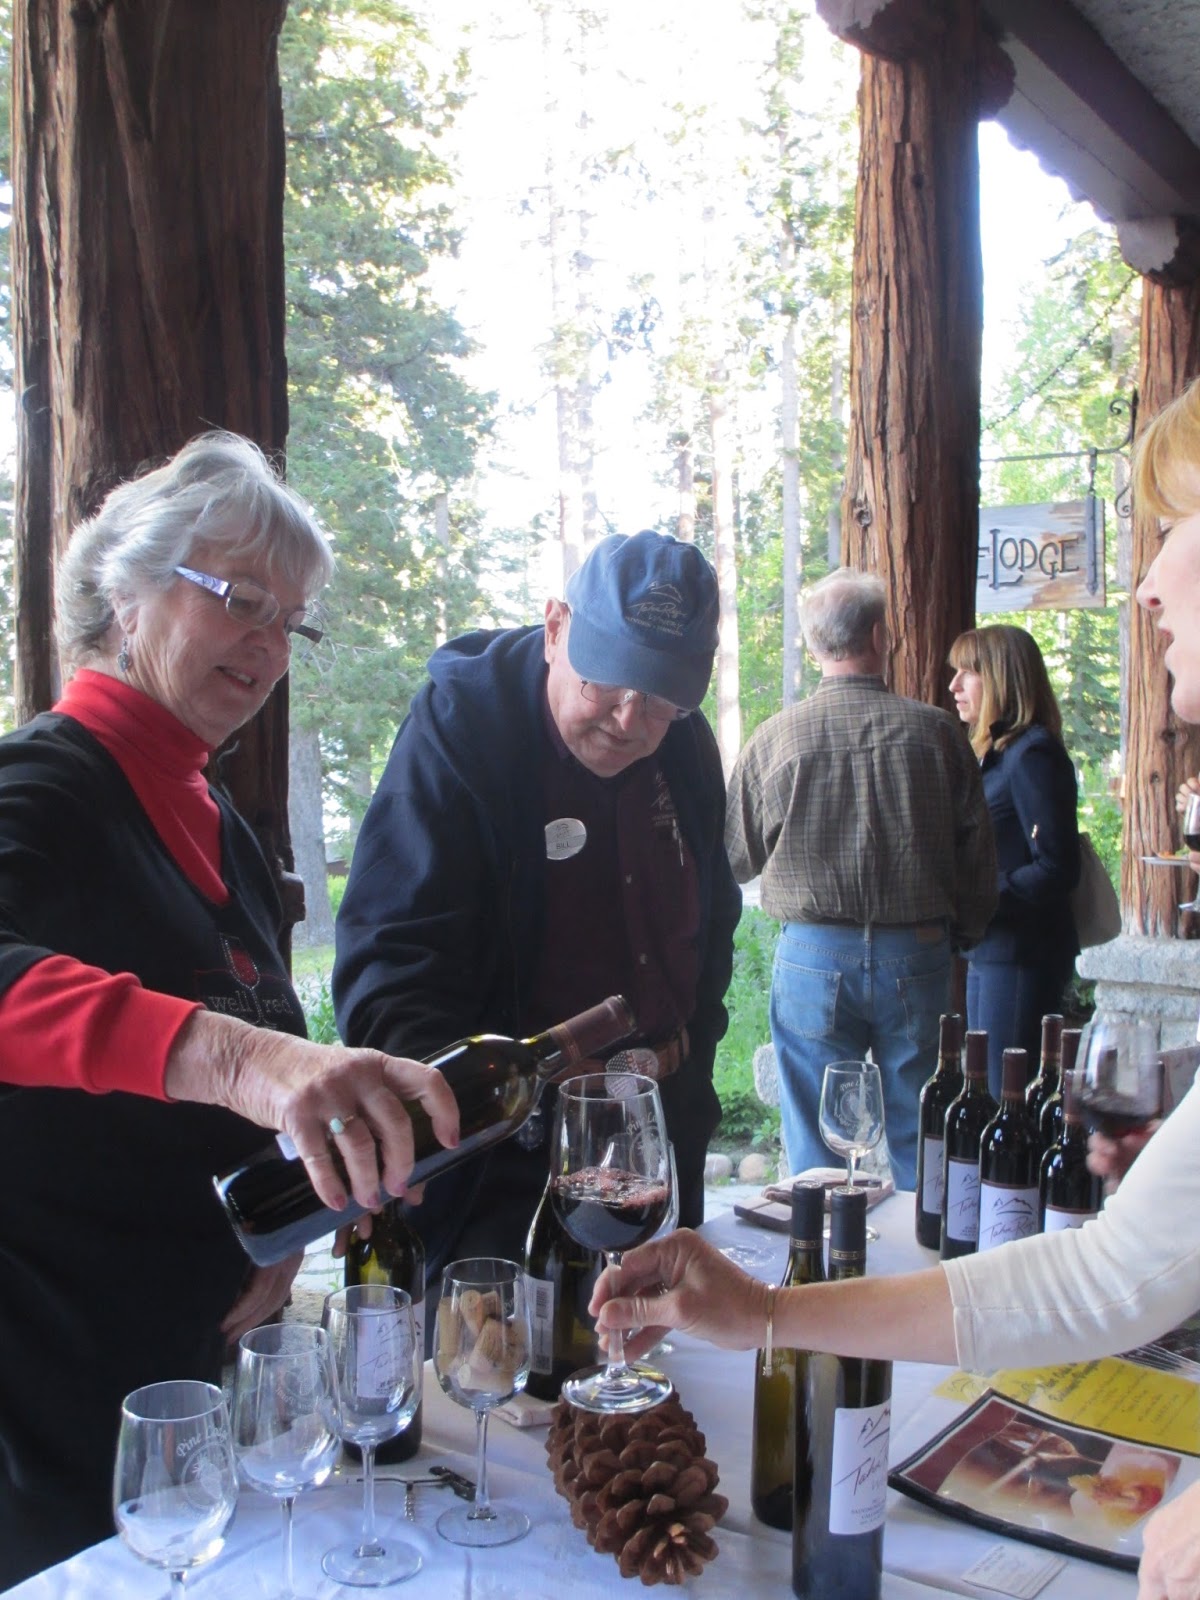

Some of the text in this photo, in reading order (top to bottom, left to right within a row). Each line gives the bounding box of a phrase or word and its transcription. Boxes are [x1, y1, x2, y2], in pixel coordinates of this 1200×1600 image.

[989, 528, 1080, 590] LODGE
[208, 990, 294, 1015] well red
[626, 1116, 645, 1136] Pin
[176, 1432, 202, 1457] Pine
